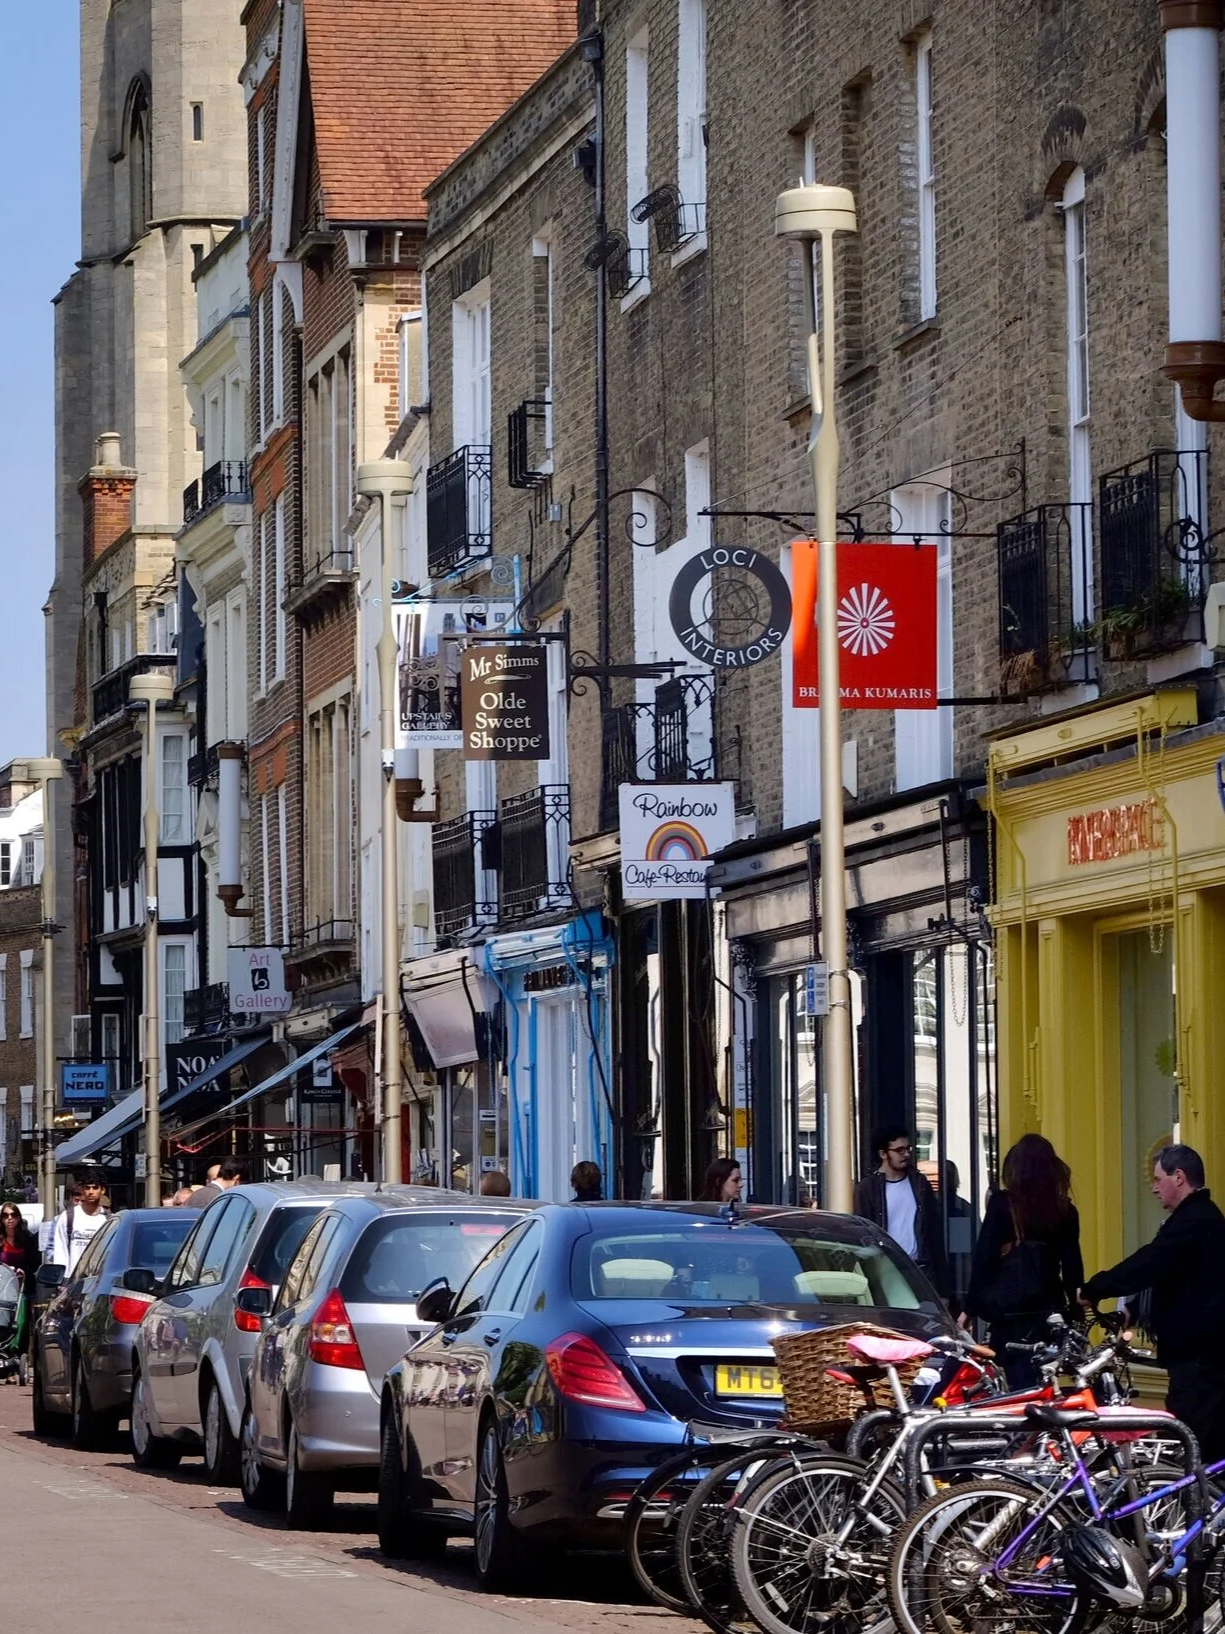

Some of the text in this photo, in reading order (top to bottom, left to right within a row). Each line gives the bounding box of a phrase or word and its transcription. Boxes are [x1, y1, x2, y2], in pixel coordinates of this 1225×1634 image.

[700, 549, 757, 569] LOCI
[680, 627, 783, 666] INTERIORS
[470, 653, 539, 681] Mr Simms
[480, 692, 526, 710] Olde
[799, 687, 932, 698] BRMA KUMARIS
[401, 712, 452, 720] UPSTAIRS
[475, 712, 532, 729] Sweet
[401, 722, 450, 730] GALLERY
[633, 793, 717, 818] Rainbow
[625, 864, 706, 888] Cafe-Restau
[249, 953, 271, 966] Art
[235, 994, 287, 1009] Gallery
[65, 1081, 104, 1090] NERO
